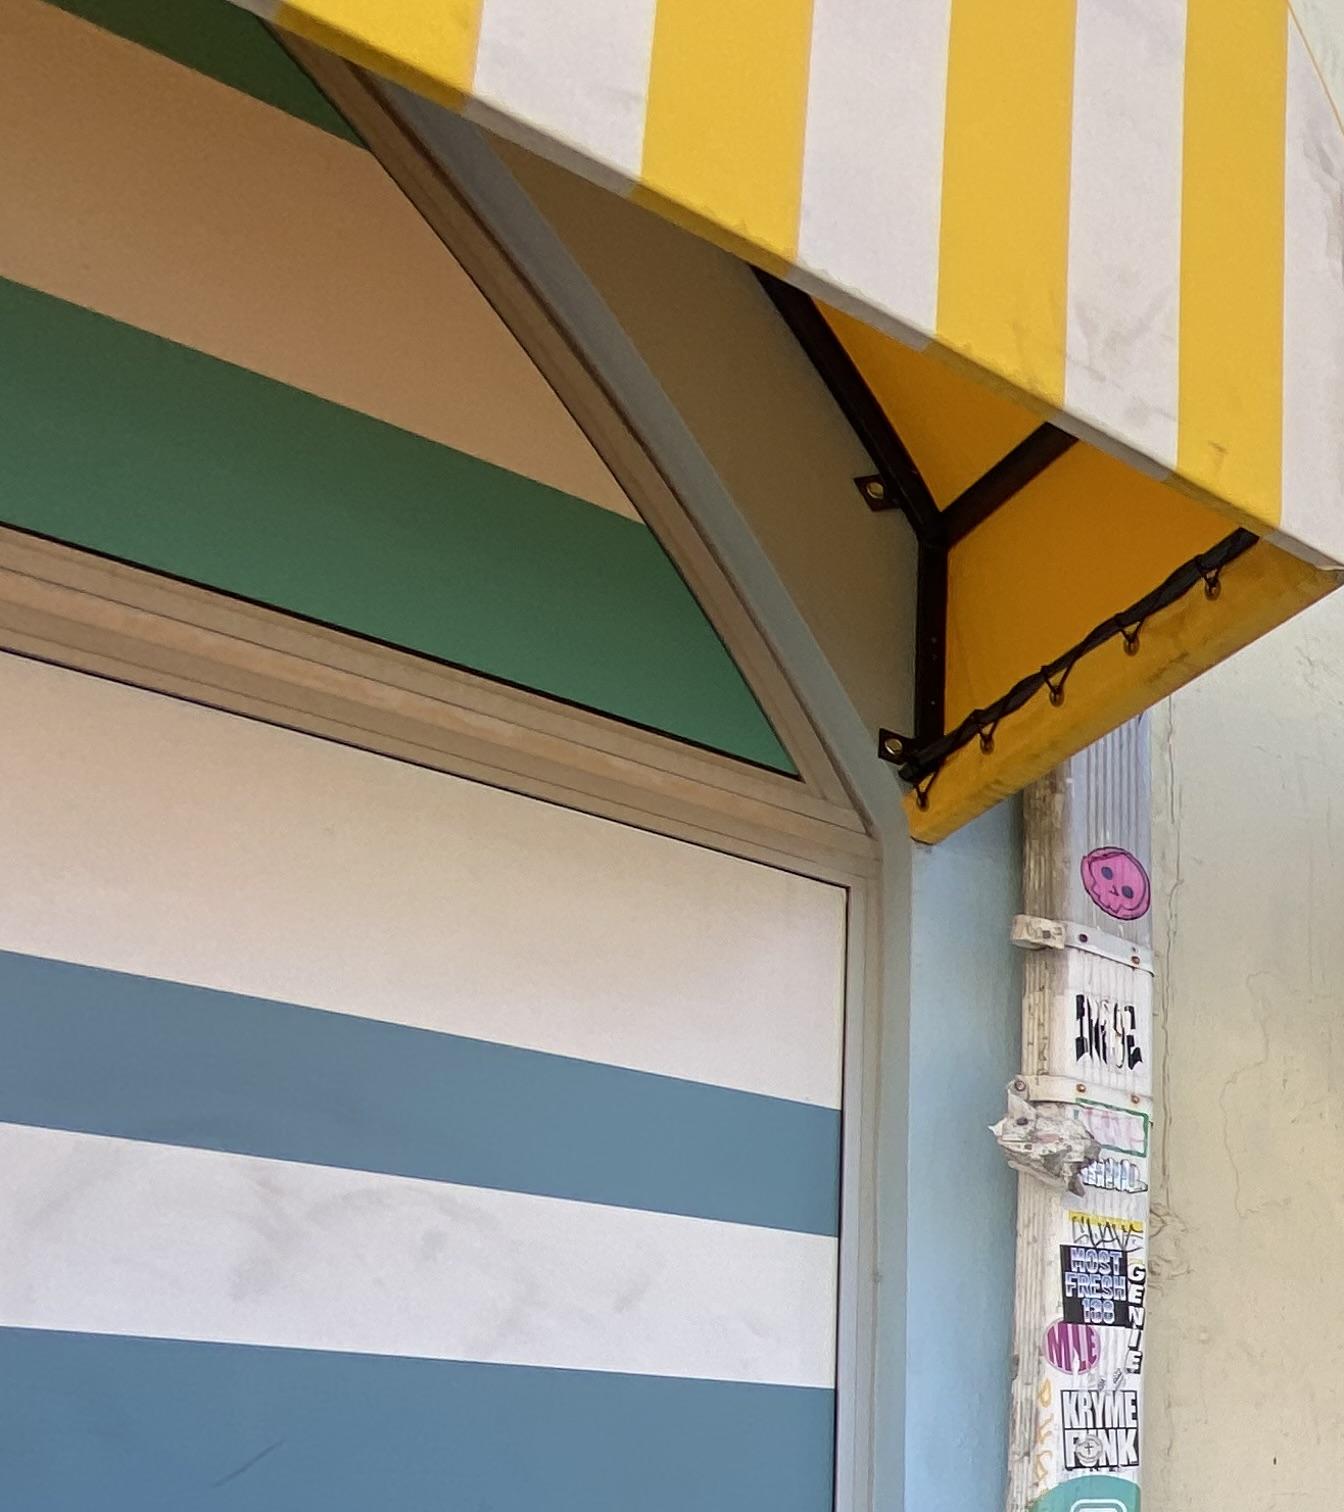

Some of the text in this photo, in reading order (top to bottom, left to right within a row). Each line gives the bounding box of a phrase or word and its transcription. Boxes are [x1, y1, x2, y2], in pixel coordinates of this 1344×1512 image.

[1065, 1272, 1126, 1301] FRESH
[1126, 1263, 1147, 1374] GENIE
[1062, 1391, 1138, 1429] KRYME
